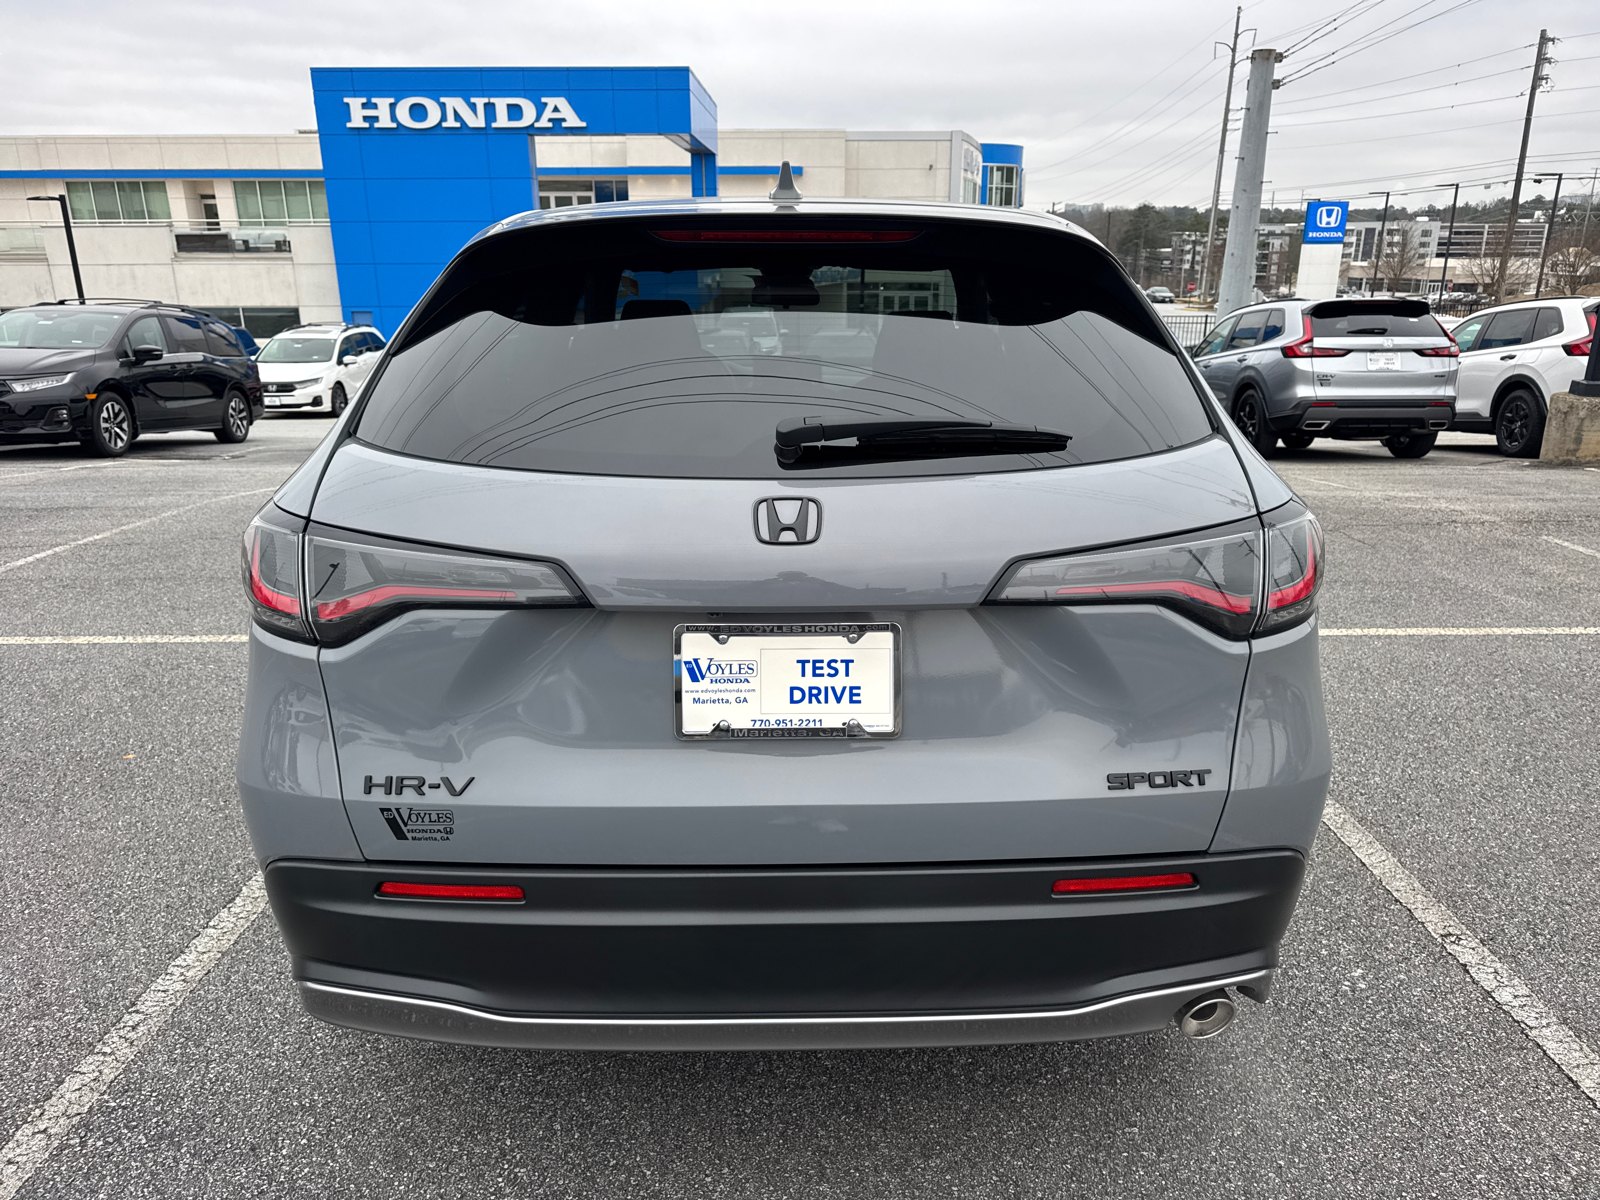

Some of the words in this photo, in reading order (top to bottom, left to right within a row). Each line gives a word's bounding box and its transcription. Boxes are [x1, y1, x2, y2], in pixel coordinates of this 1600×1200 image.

[343, 96, 588, 130] HONDA
[692, 657, 755, 681] VOYLES
[796, 658, 855, 678] TEST
[692, 696, 732, 705] Marietta,
[734, 696, 749, 704] GA
[789, 685, 862, 705] DRIVE
[733, 728, 812, 738] Marietta,
[818, 728, 844, 737] GA
[750, 718, 823, 728] 770-951-2211
[363, 774, 476, 797] HR-V
[1106, 768, 1213, 790] SPORT
[383, 811, 394, 819] ED
[394, 807, 453, 828] VOYLES
